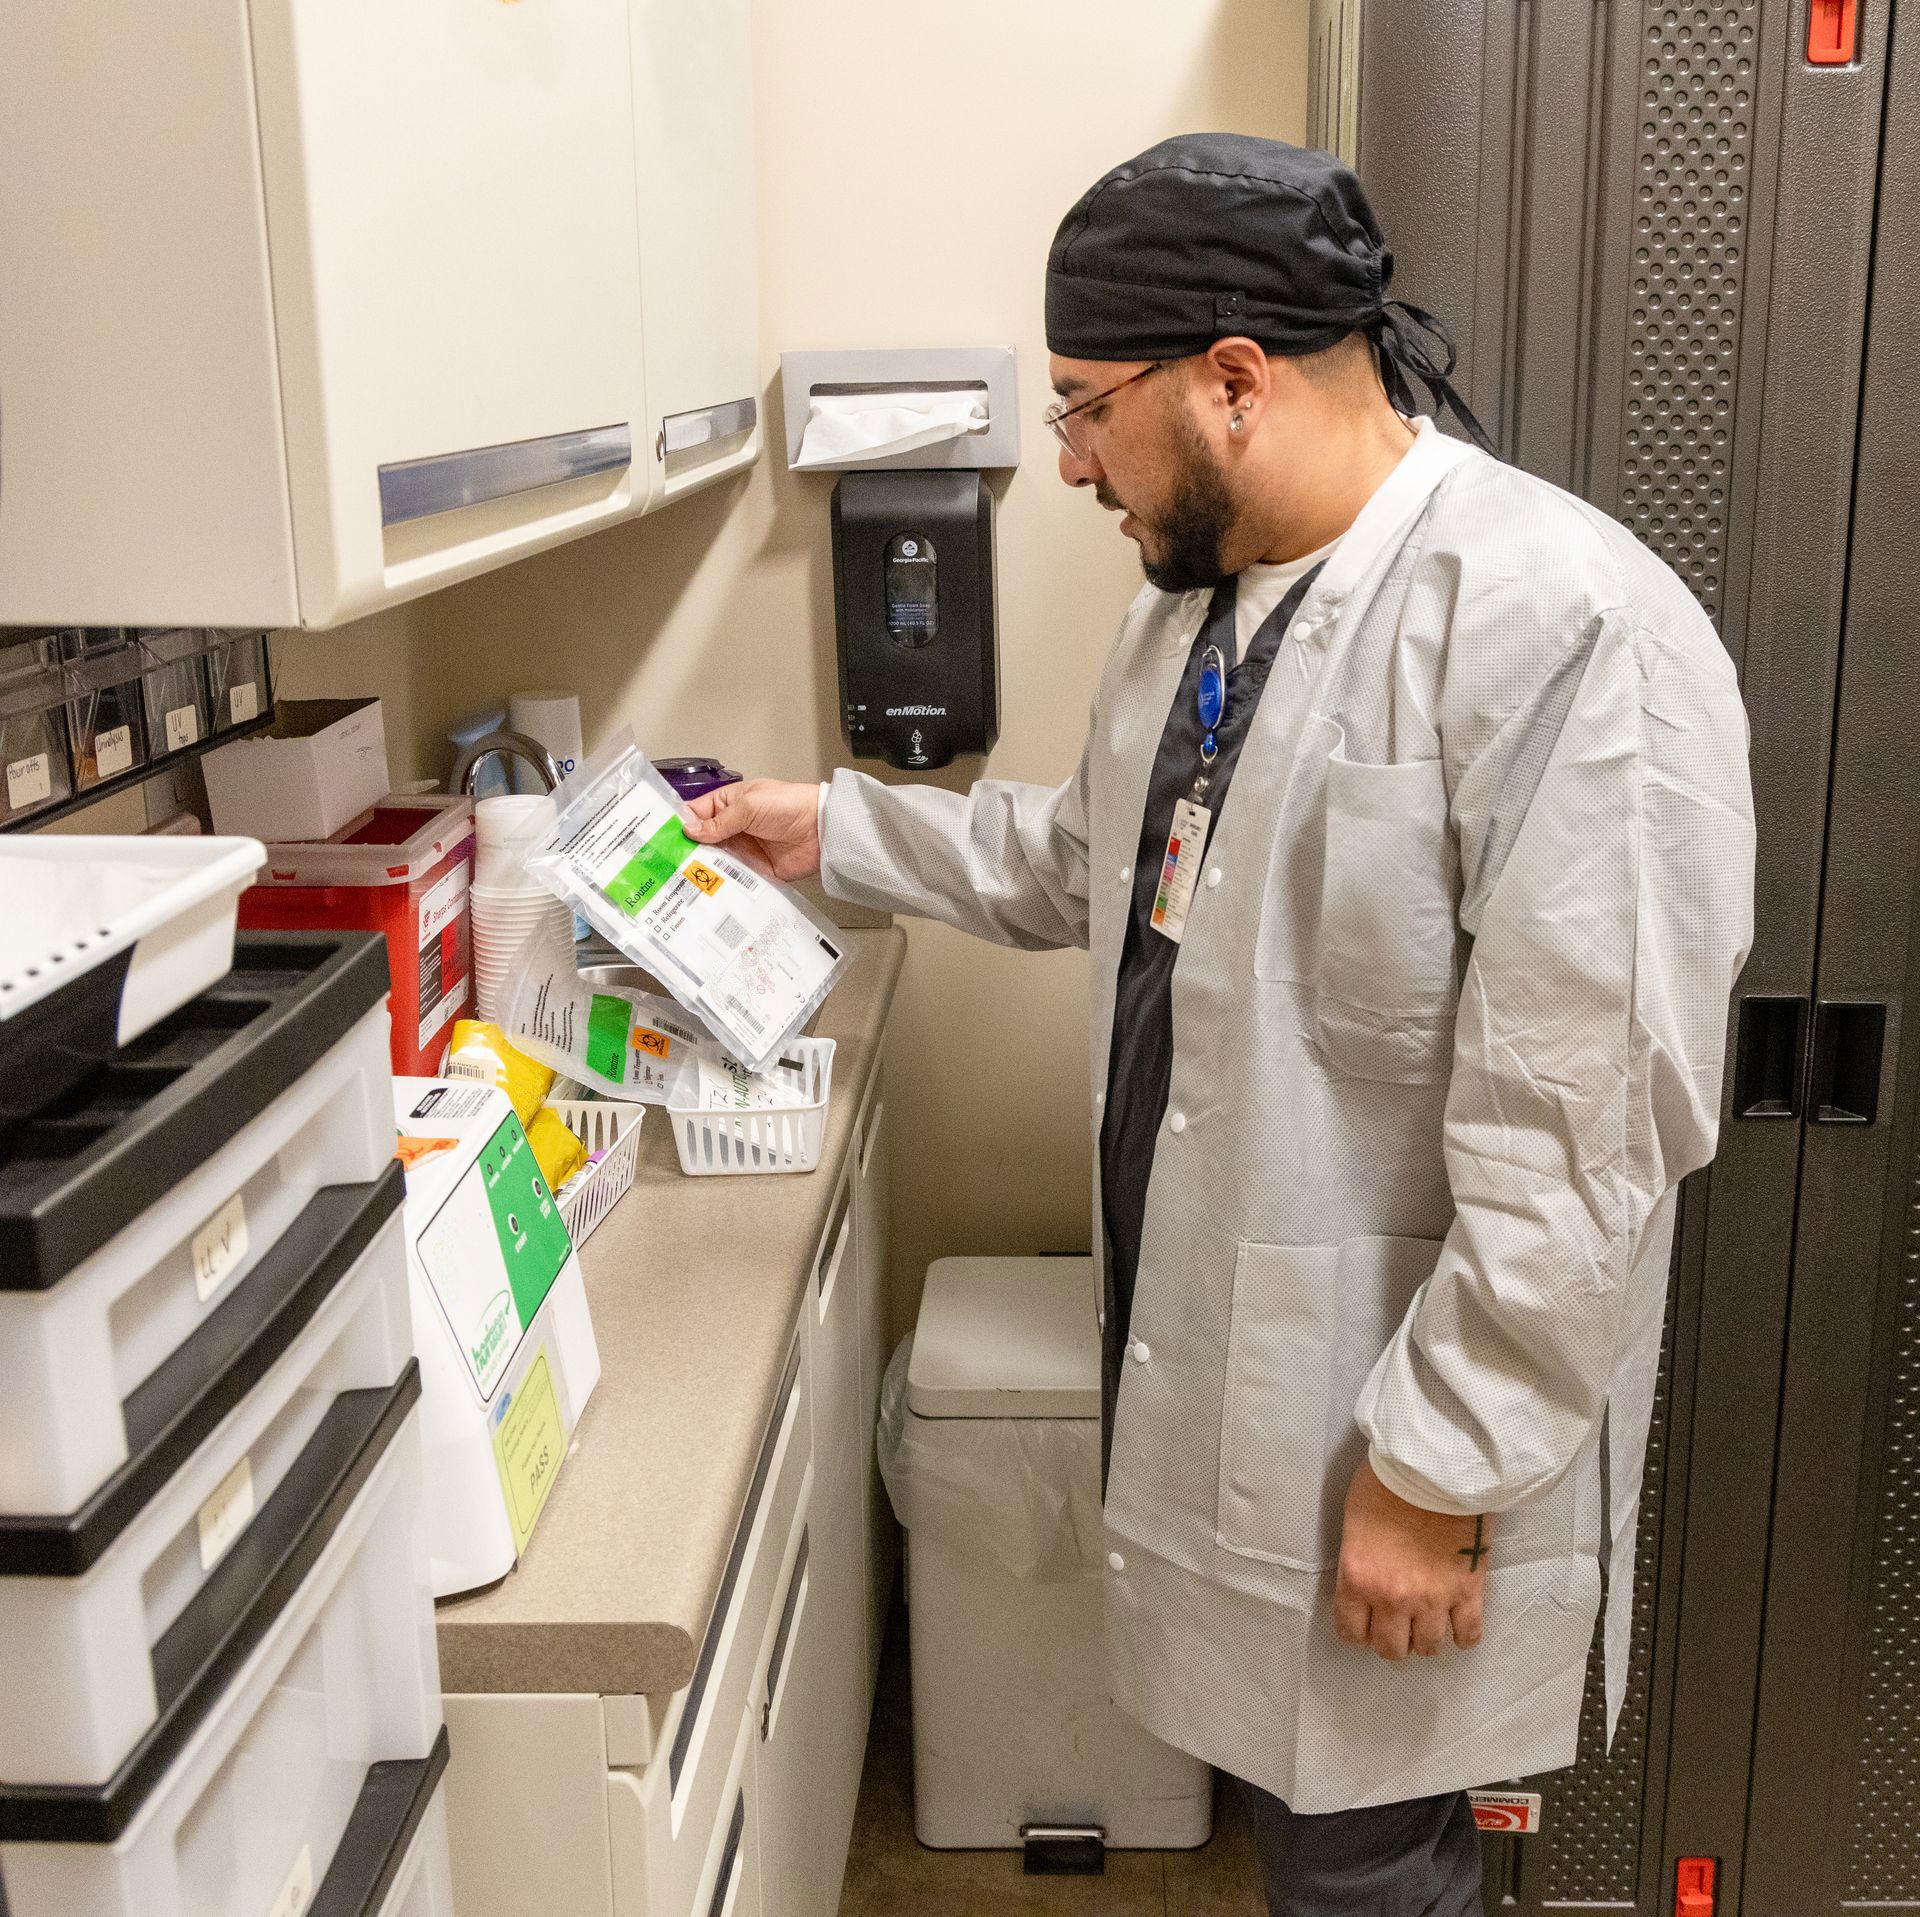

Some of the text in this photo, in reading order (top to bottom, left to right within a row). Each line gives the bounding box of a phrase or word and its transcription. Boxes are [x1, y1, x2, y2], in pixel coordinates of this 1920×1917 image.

[625, 877, 656, 908] Routine
[653, 877, 688, 916] Room Temperature
[661, 898, 685, 924] Refrigerate
[608, 1052, 620, 1079] Routine
[529, 1446, 551, 1496] PASS
